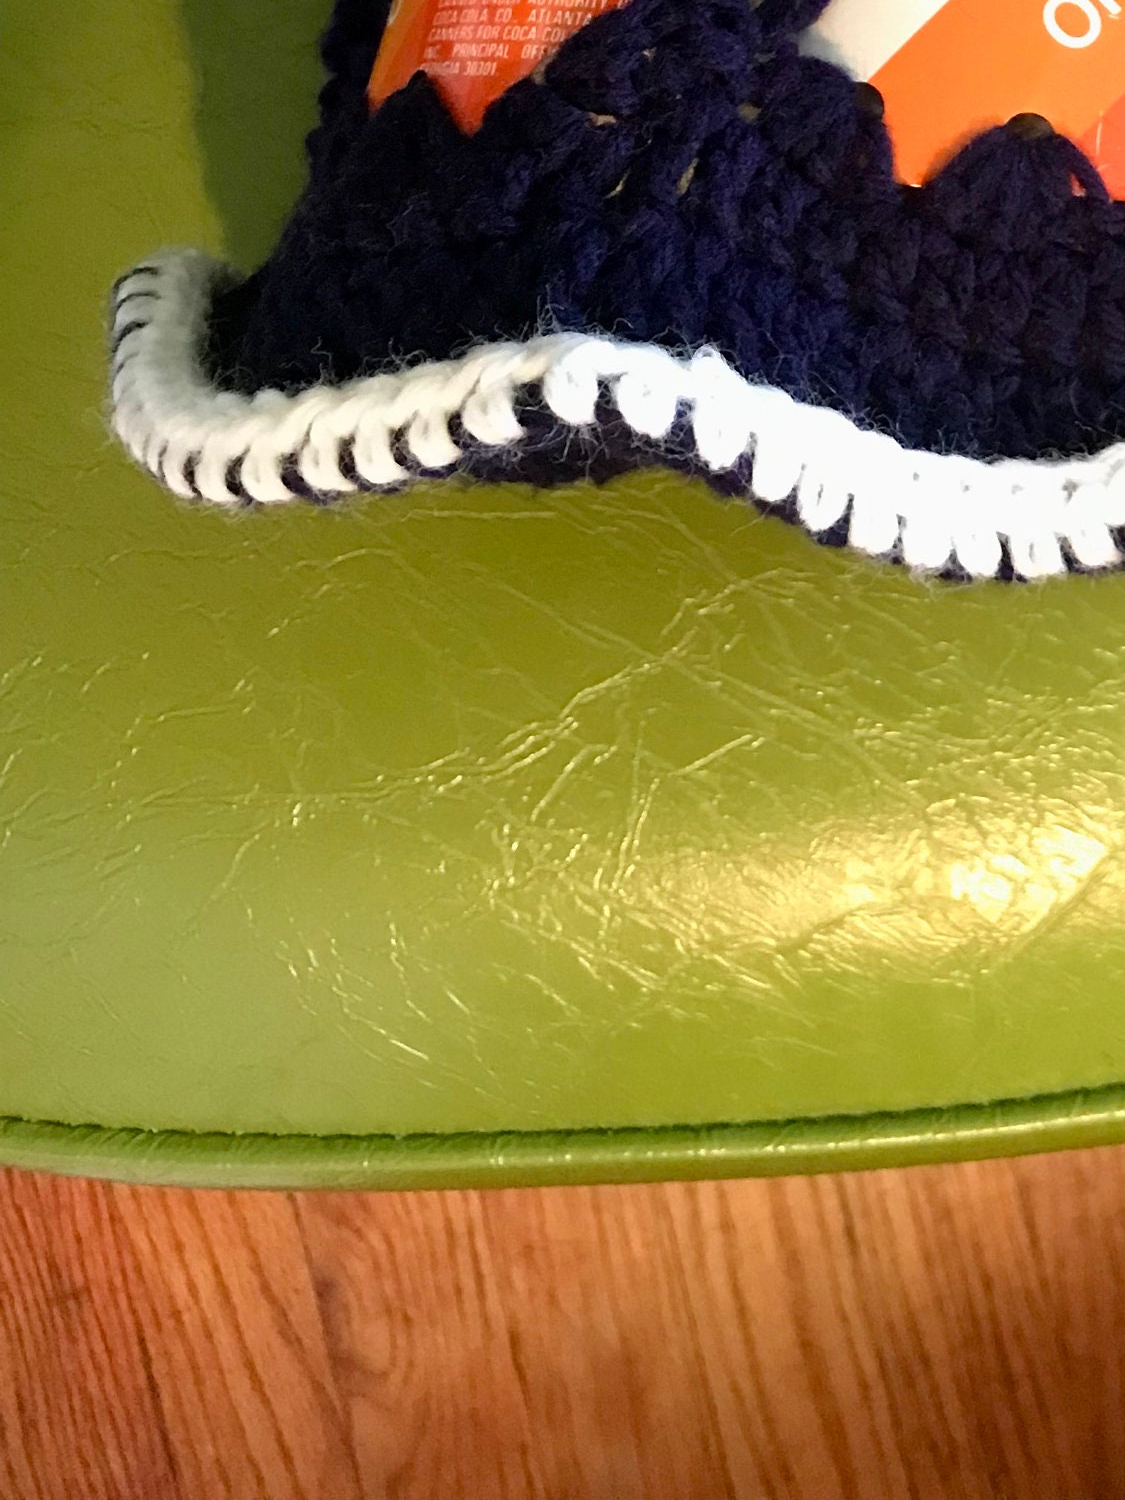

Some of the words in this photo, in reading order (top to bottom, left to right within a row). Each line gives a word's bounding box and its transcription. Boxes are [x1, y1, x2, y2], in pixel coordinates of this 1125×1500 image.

[527, 8, 593, 26] ATLANTA
[475, 24, 500, 40] FOR
[451, 42, 510, 60] PRINCIPAL
